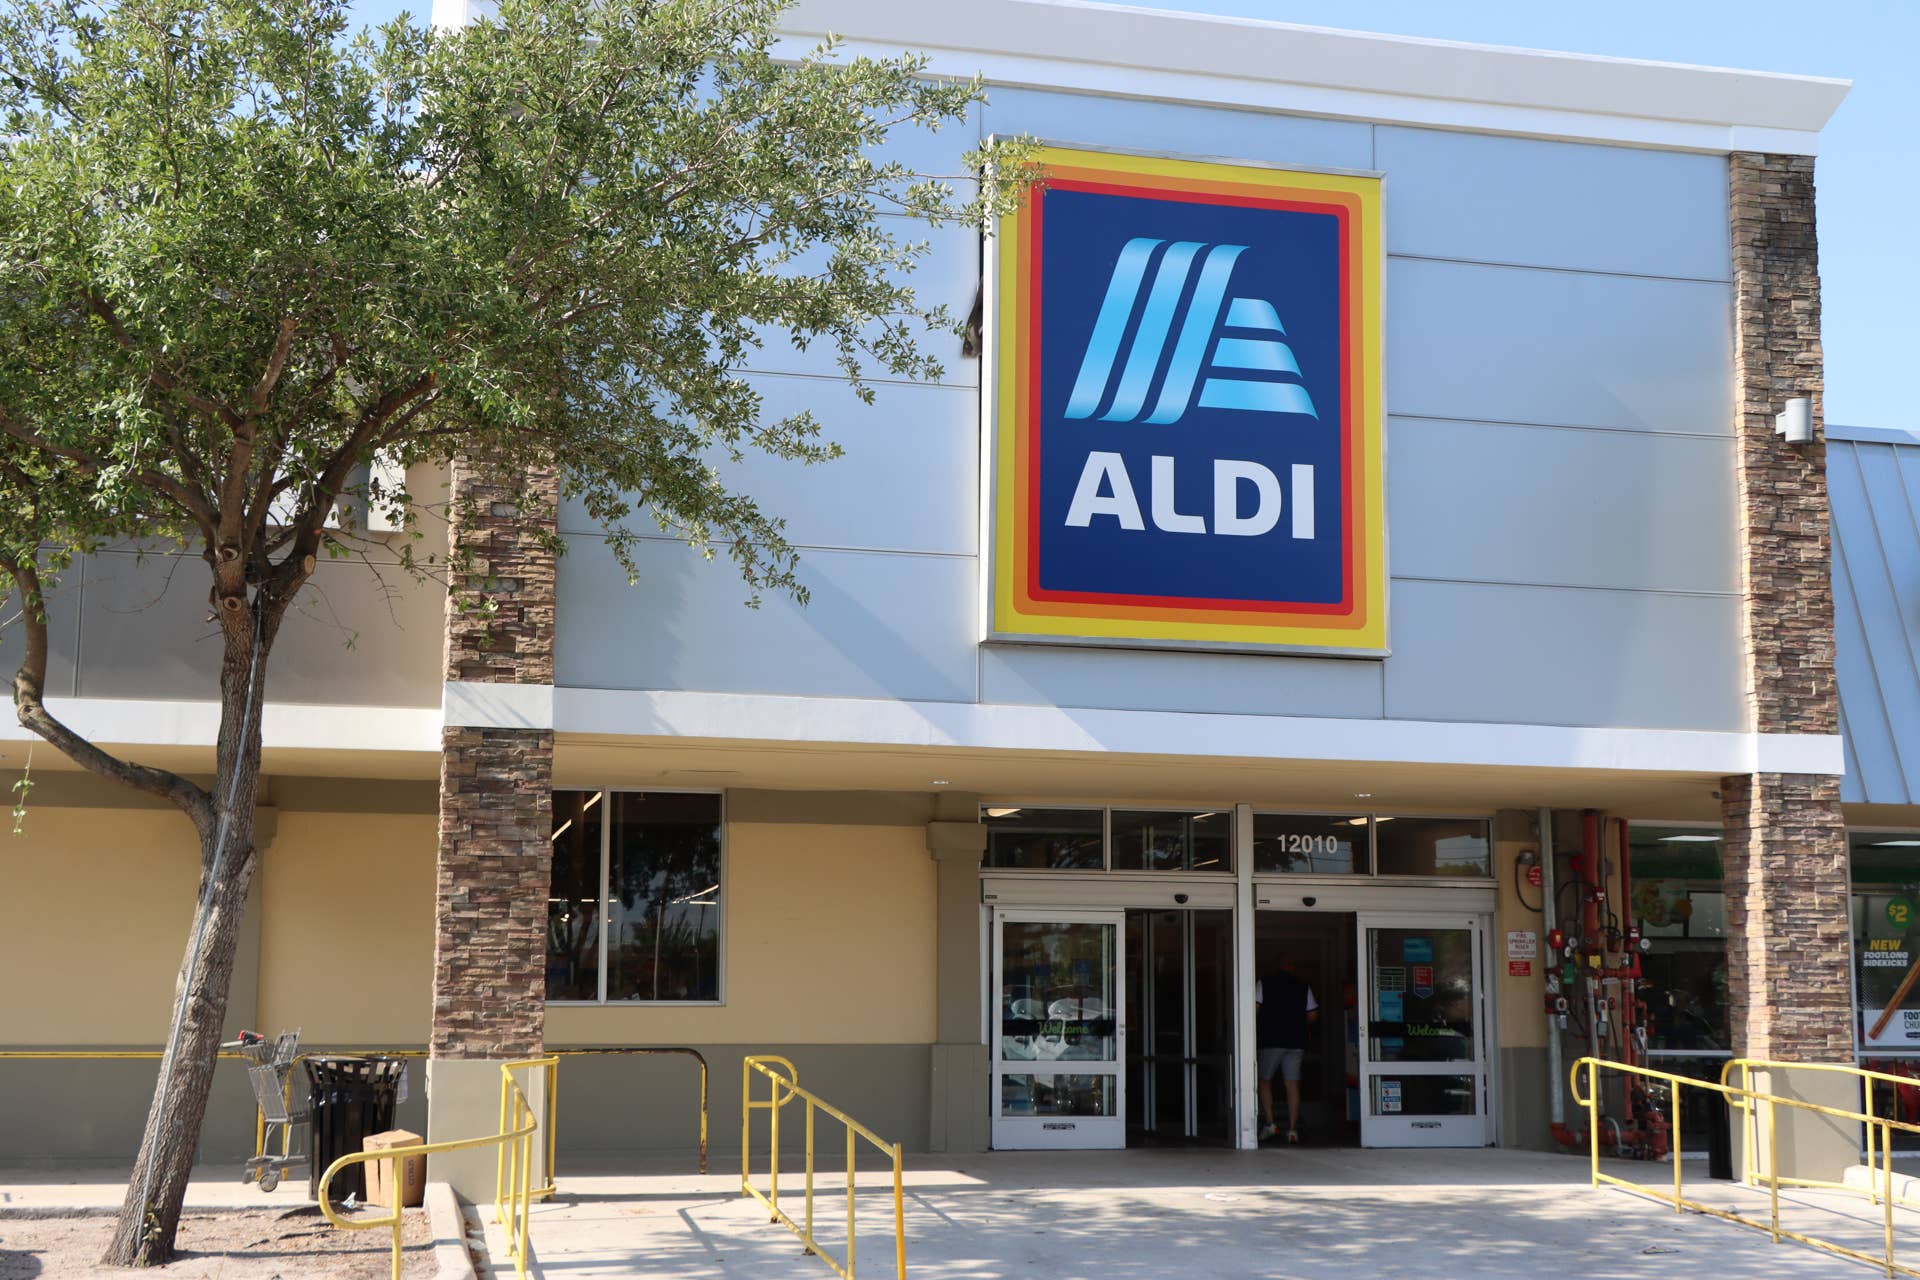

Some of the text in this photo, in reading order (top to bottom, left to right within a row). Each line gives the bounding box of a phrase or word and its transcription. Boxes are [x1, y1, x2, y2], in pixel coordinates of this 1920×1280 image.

[1064, 450, 1315, 540] ALDI
[1277, 834, 1338, 854] 12010
[1888, 904, 1908, 922] $2
[1870, 939, 1901, 950] NEW
[1863, 959, 1908, 967] SIDEKICKS
[1040, 1022, 1089, 1035] Welcome
[1407, 1023, 1457, 1036] Welcome
